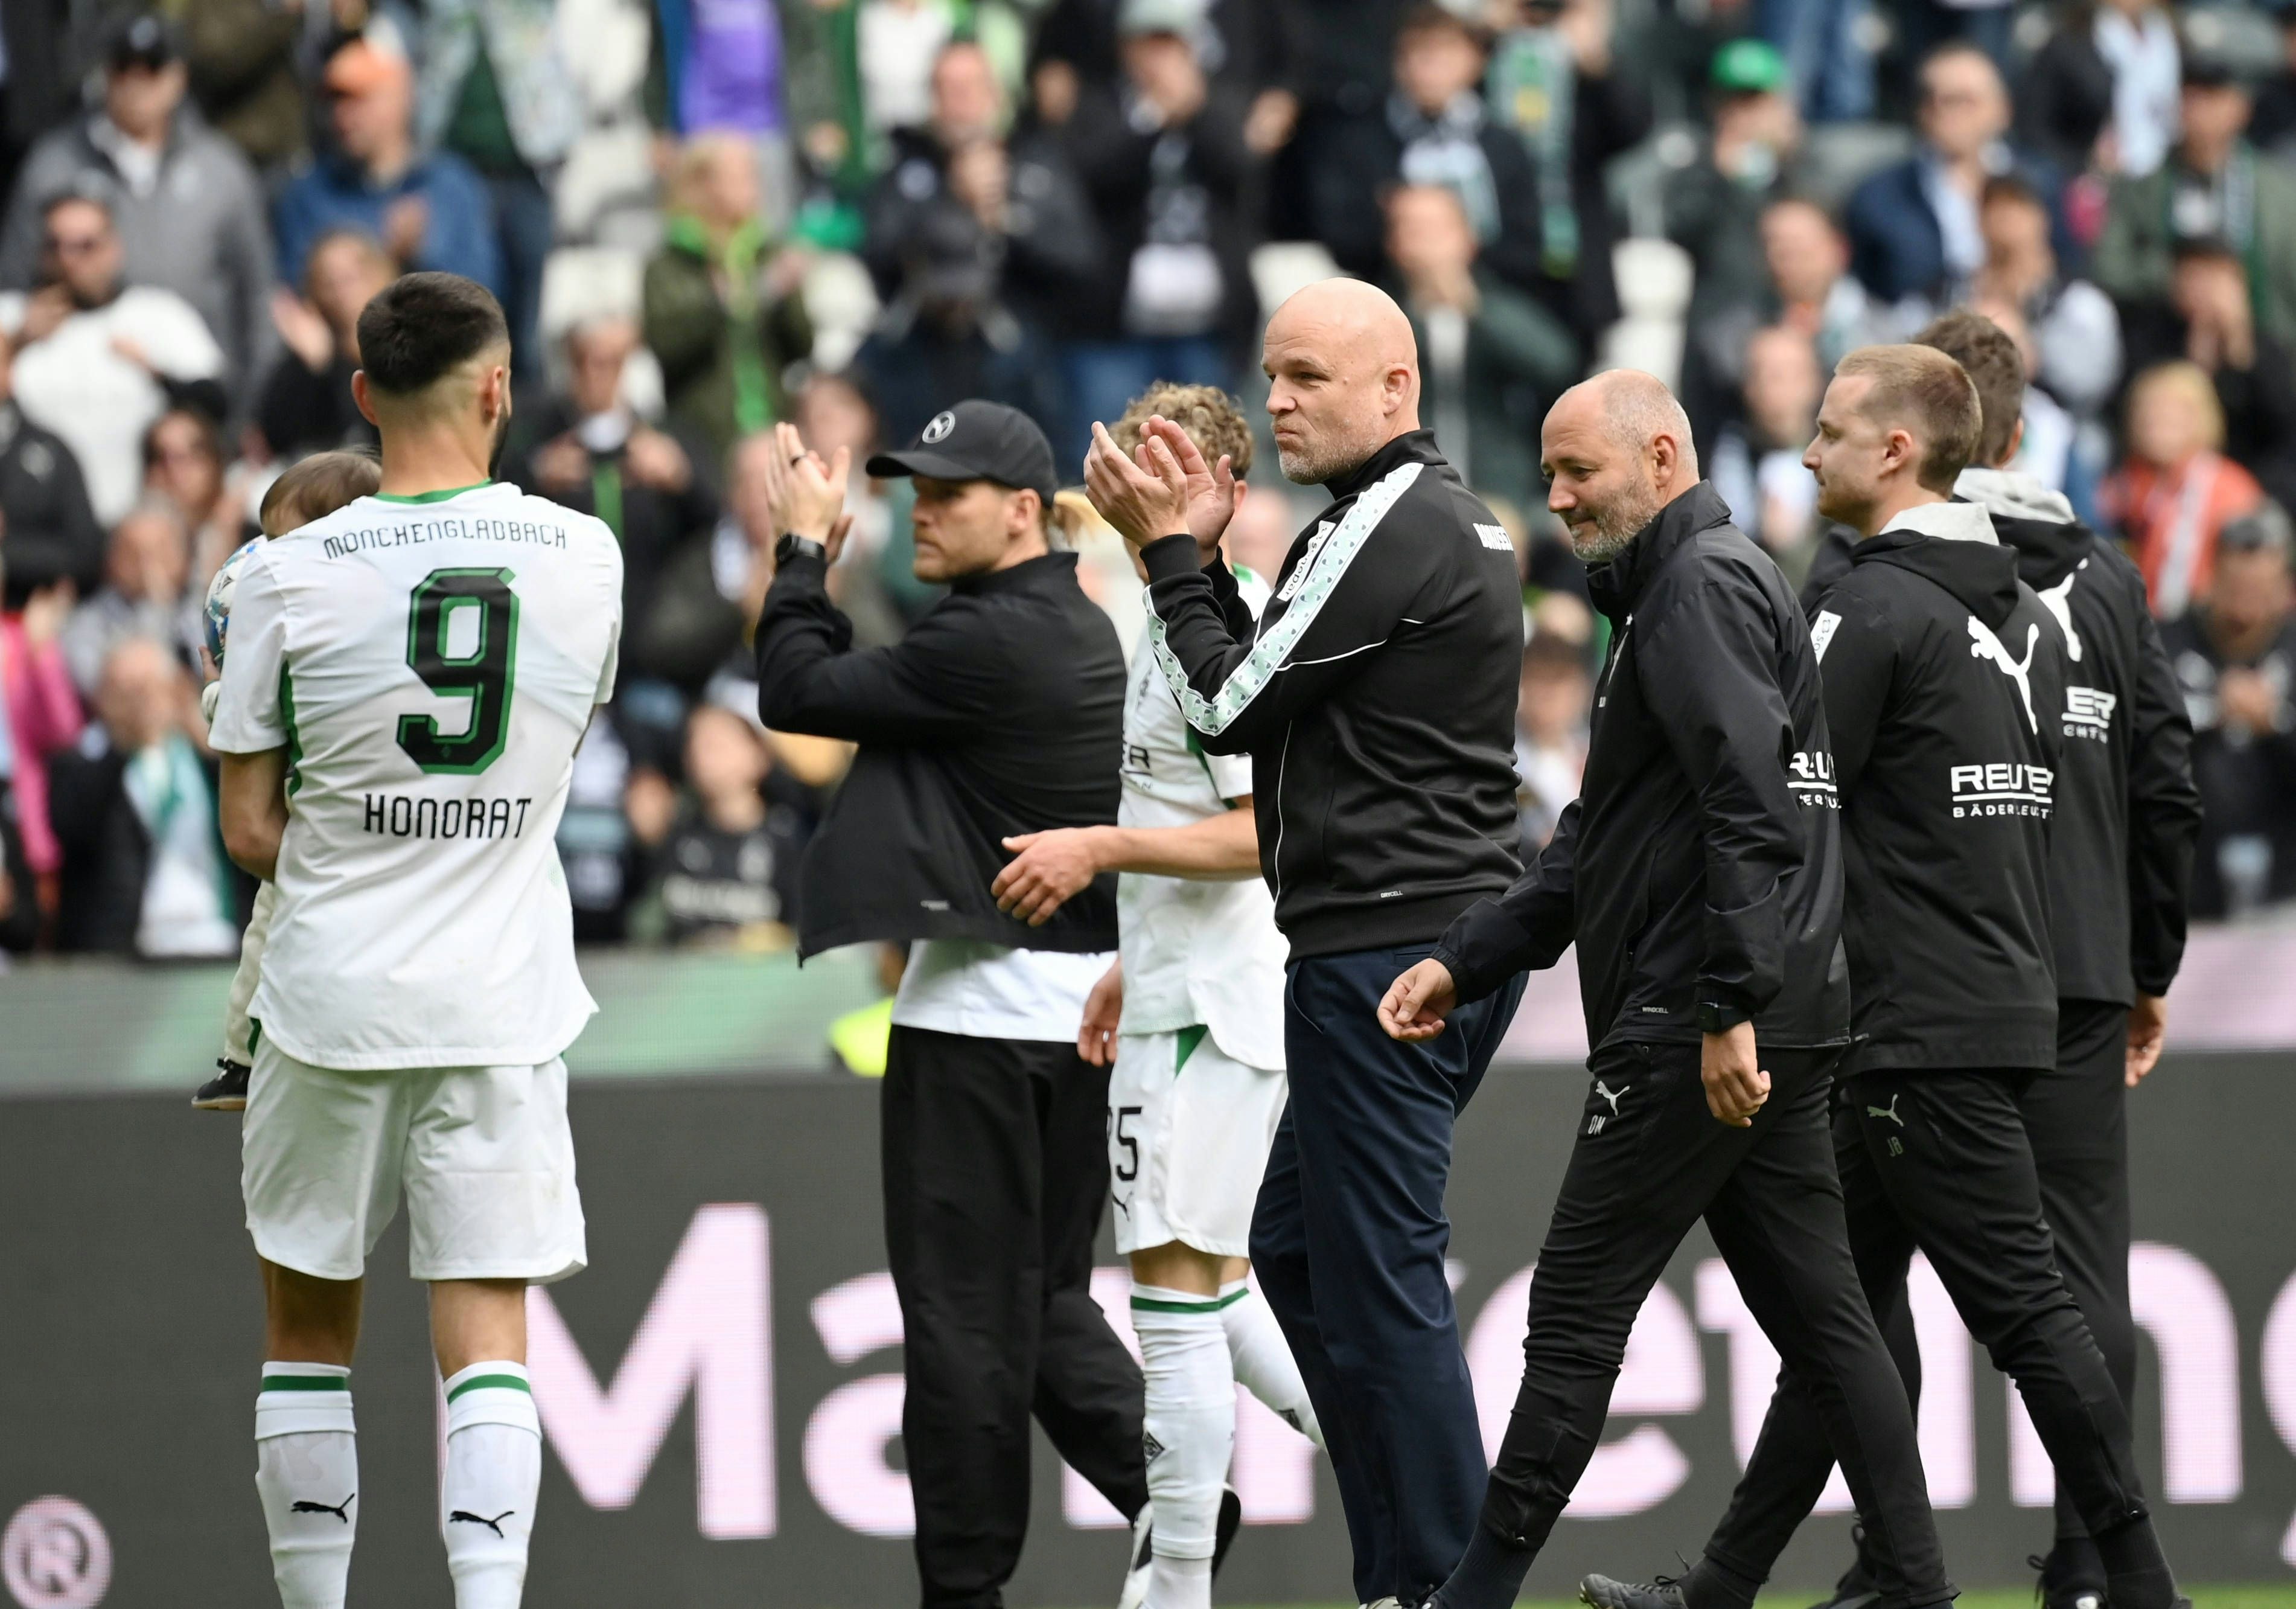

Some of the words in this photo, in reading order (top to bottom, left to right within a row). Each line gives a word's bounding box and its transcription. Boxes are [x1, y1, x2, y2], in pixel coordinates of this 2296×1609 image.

[397, 567, 520, 775] 9
[363, 794, 531, 839] HONORAT
[1108, 1106, 1143, 1182] 5
